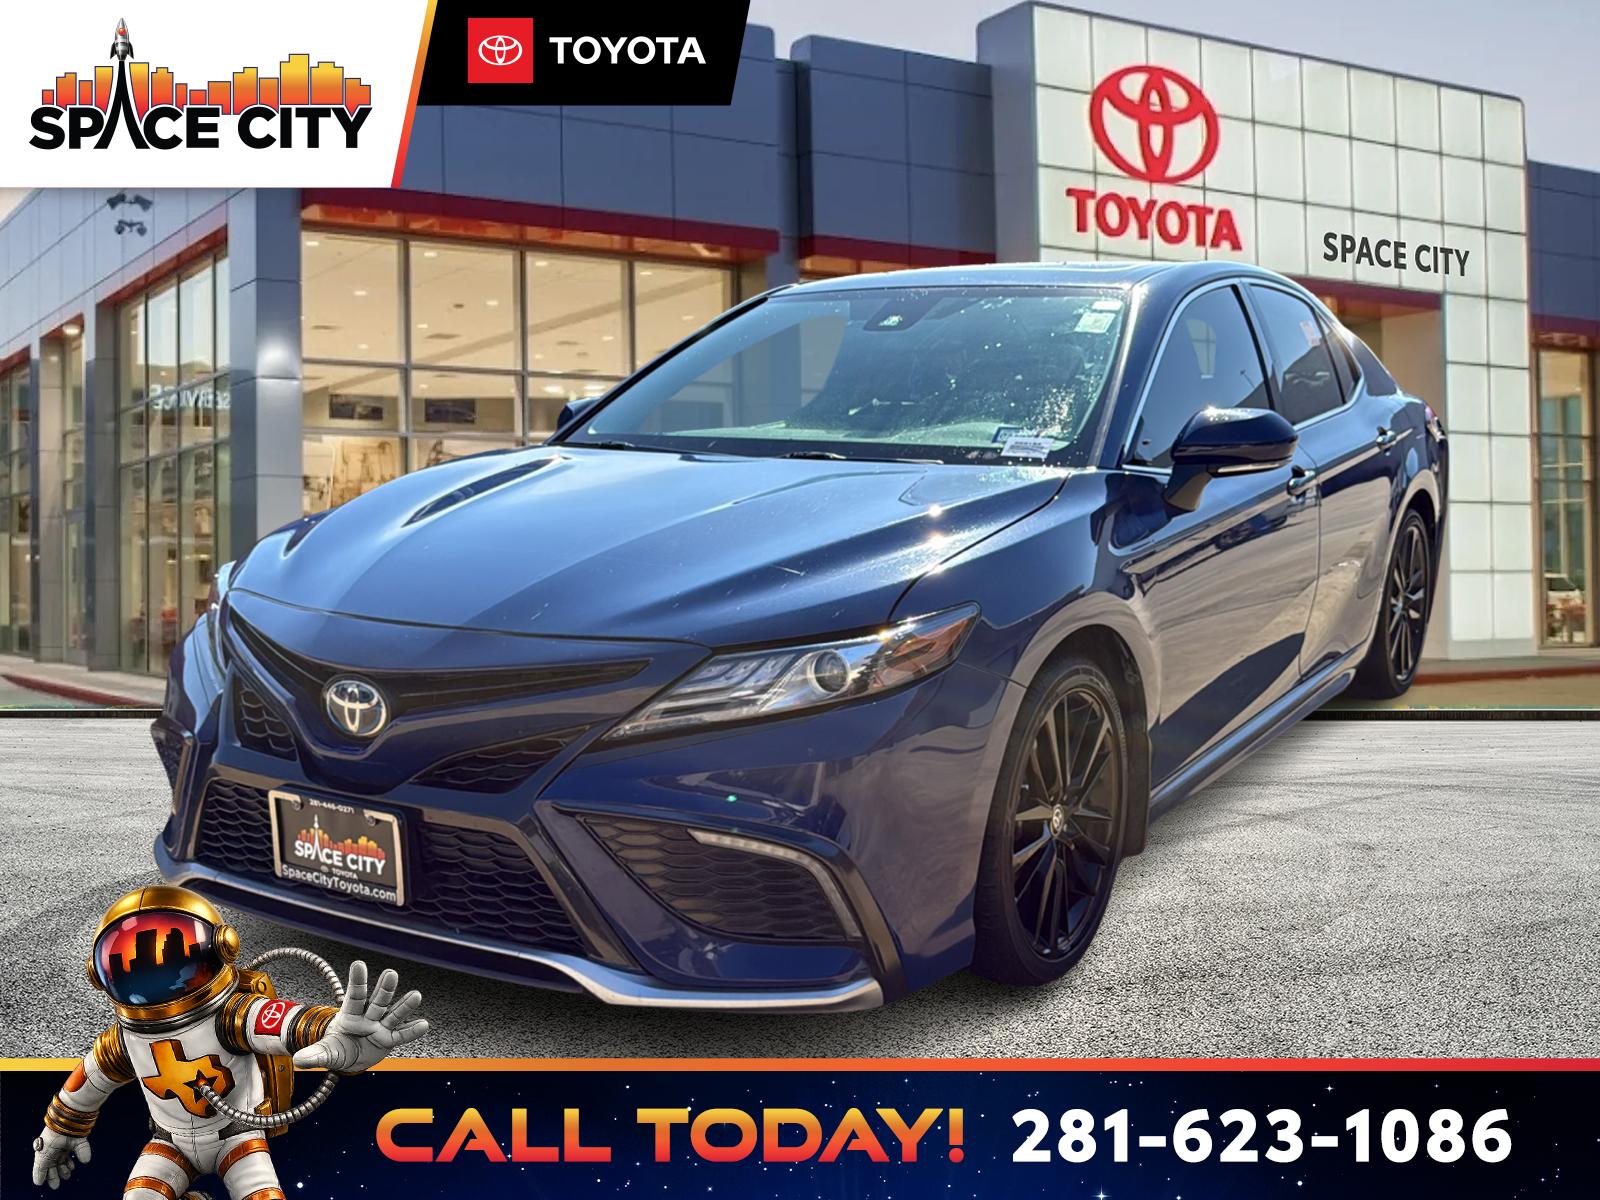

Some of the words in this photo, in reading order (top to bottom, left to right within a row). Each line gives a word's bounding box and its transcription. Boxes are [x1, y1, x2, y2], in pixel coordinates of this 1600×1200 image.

[1066, 187, 1242, 251] TOYOTA
[1323, 231, 1407, 270] SPACE
[1414, 243, 1471, 277] CITY
[294, 839, 344, 868] SPACE
[346, 852, 386, 875] CITY
[331, 867, 358, 880] TOYOTA
[282, 863, 397, 901] SpaceCityToyota.com
